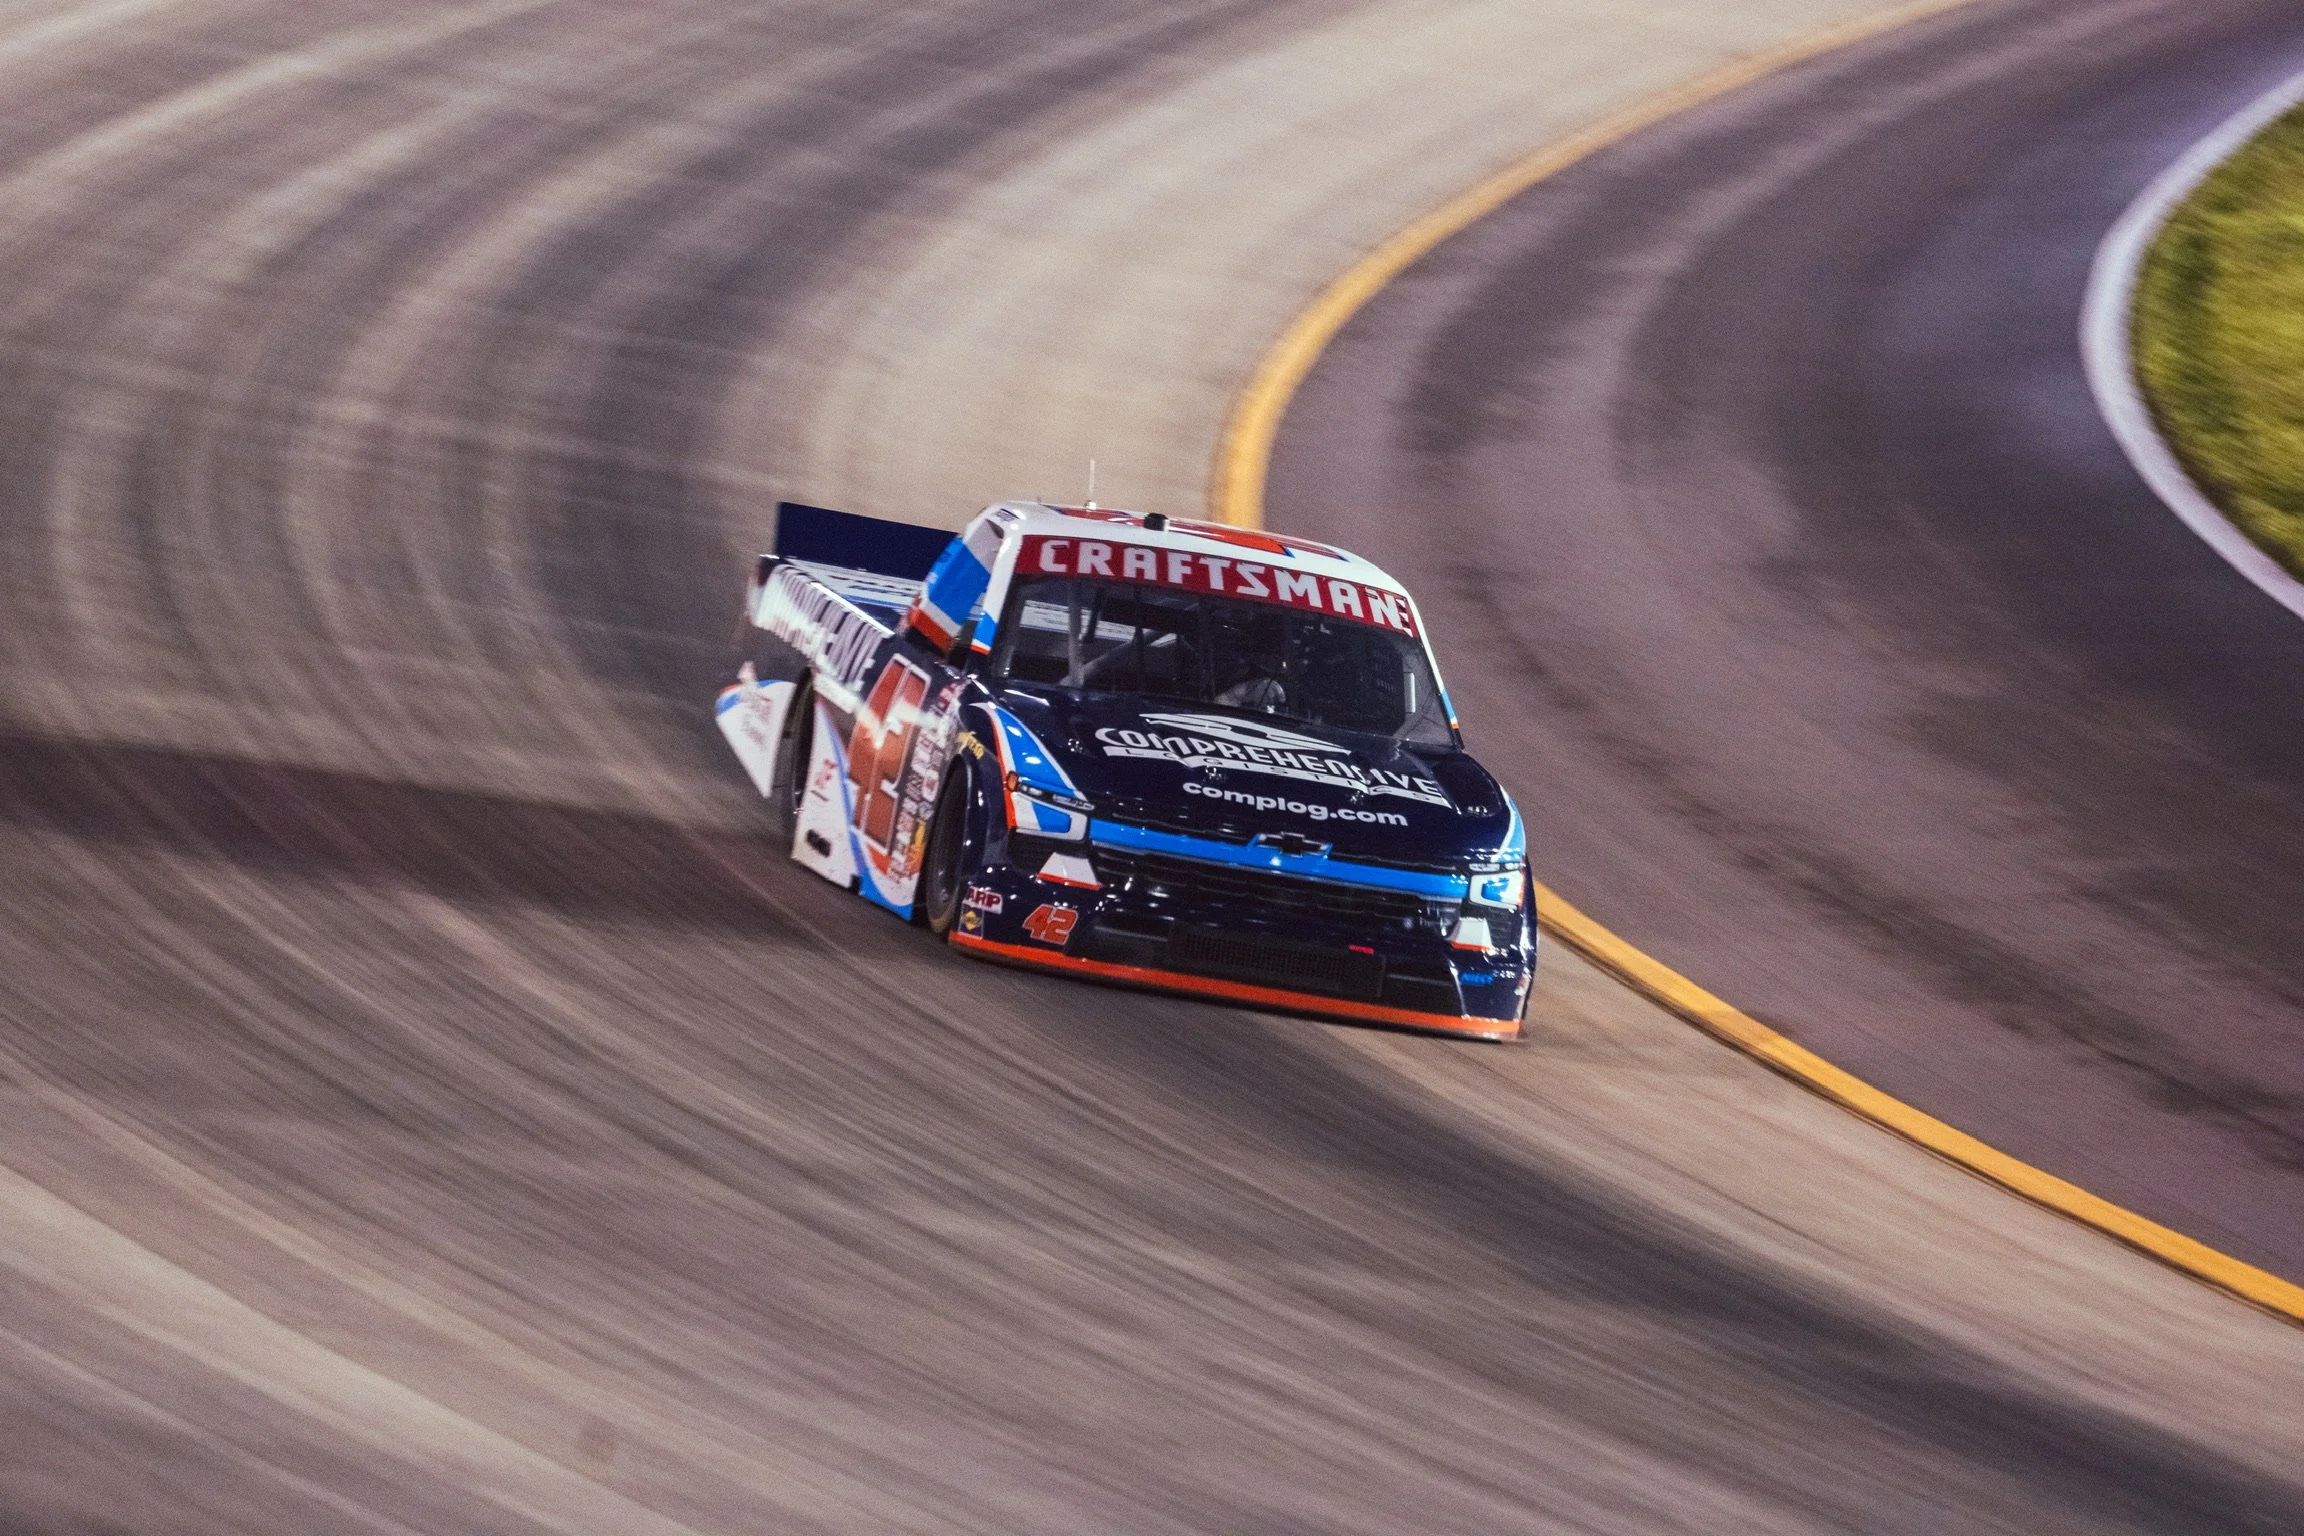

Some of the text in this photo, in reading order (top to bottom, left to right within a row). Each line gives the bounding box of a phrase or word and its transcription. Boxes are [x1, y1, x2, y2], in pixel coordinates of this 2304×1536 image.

[1039, 539, 1404, 631] CRAFTSMAN
[1095, 727, 1443, 797] COMPREHENSIVE
[1182, 781, 1408, 827] complog.com
[1022, 903, 1079, 945] 42
